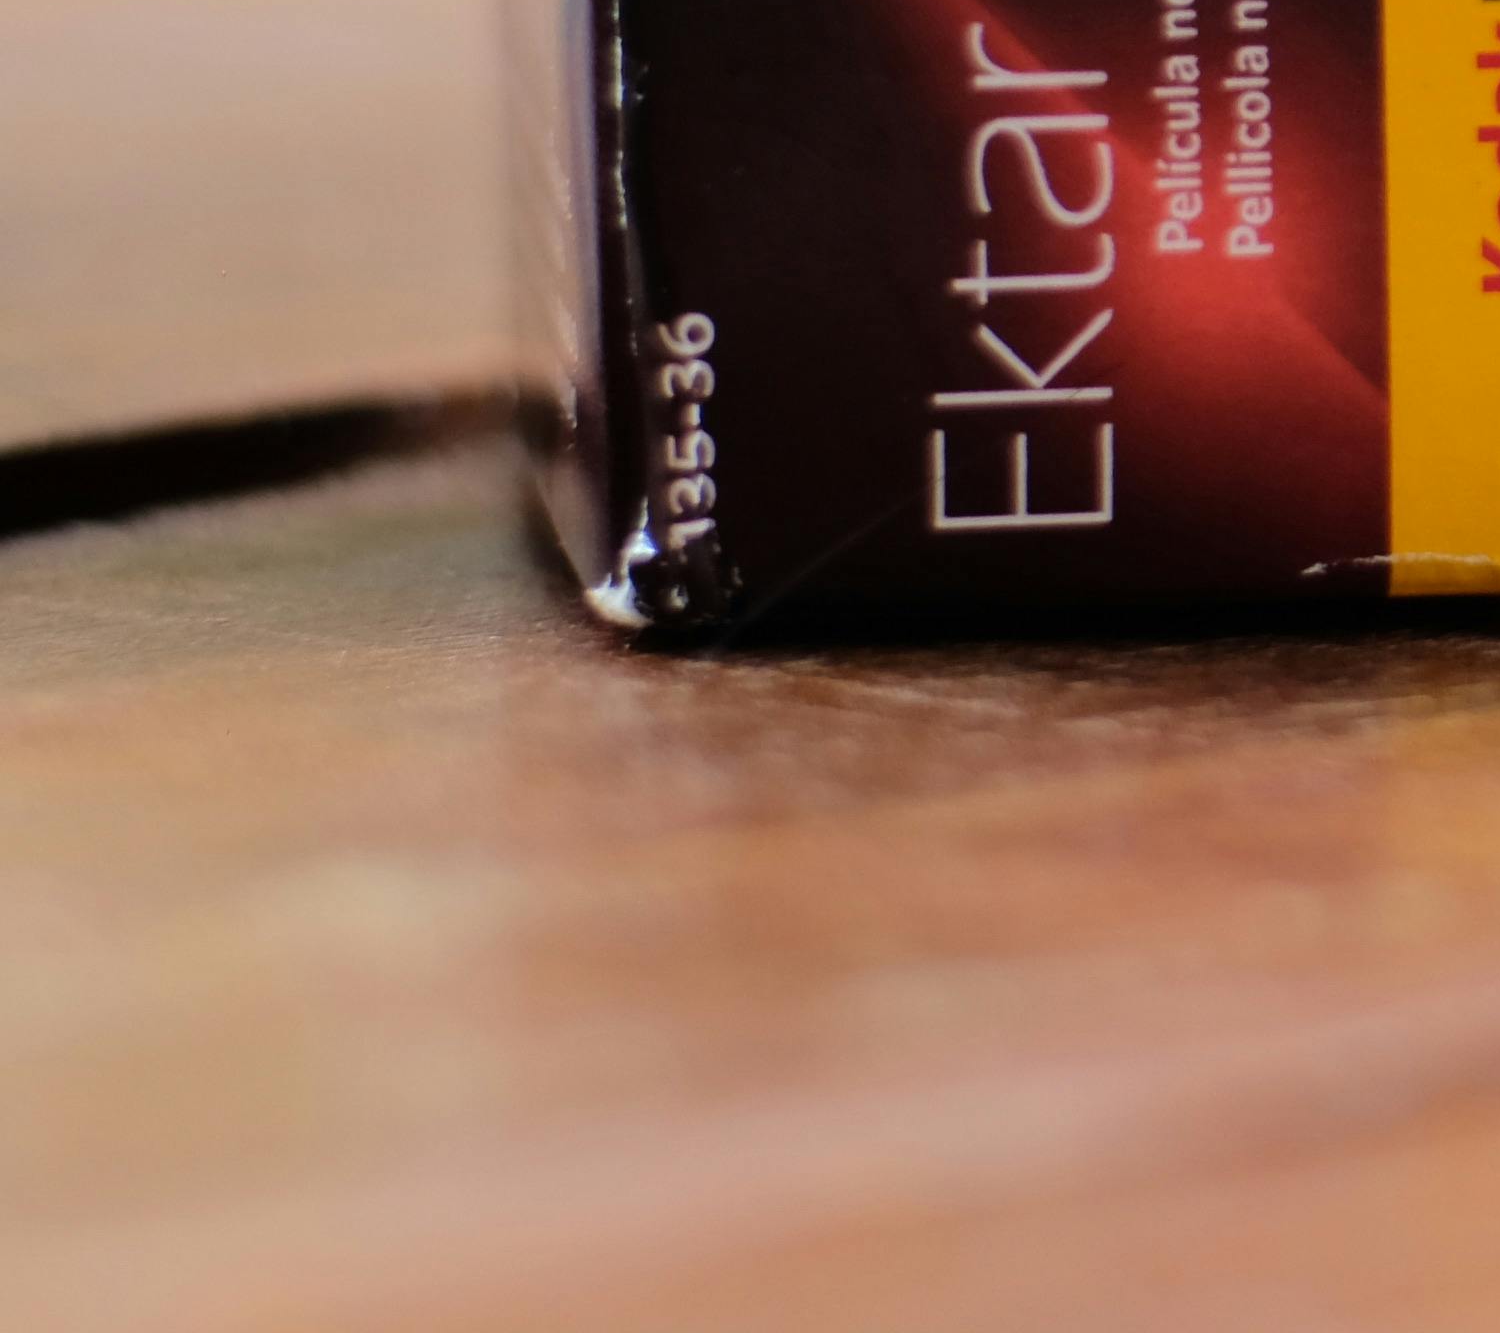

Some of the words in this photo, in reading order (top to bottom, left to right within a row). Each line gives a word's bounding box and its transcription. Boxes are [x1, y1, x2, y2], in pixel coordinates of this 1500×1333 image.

[1151, 52, 1205, 254] Película
[1222, 43, 1275, 258] Pellicola
[928, 22, 1115, 530] Ektar
[656, 310, 717, 551] 135-36
